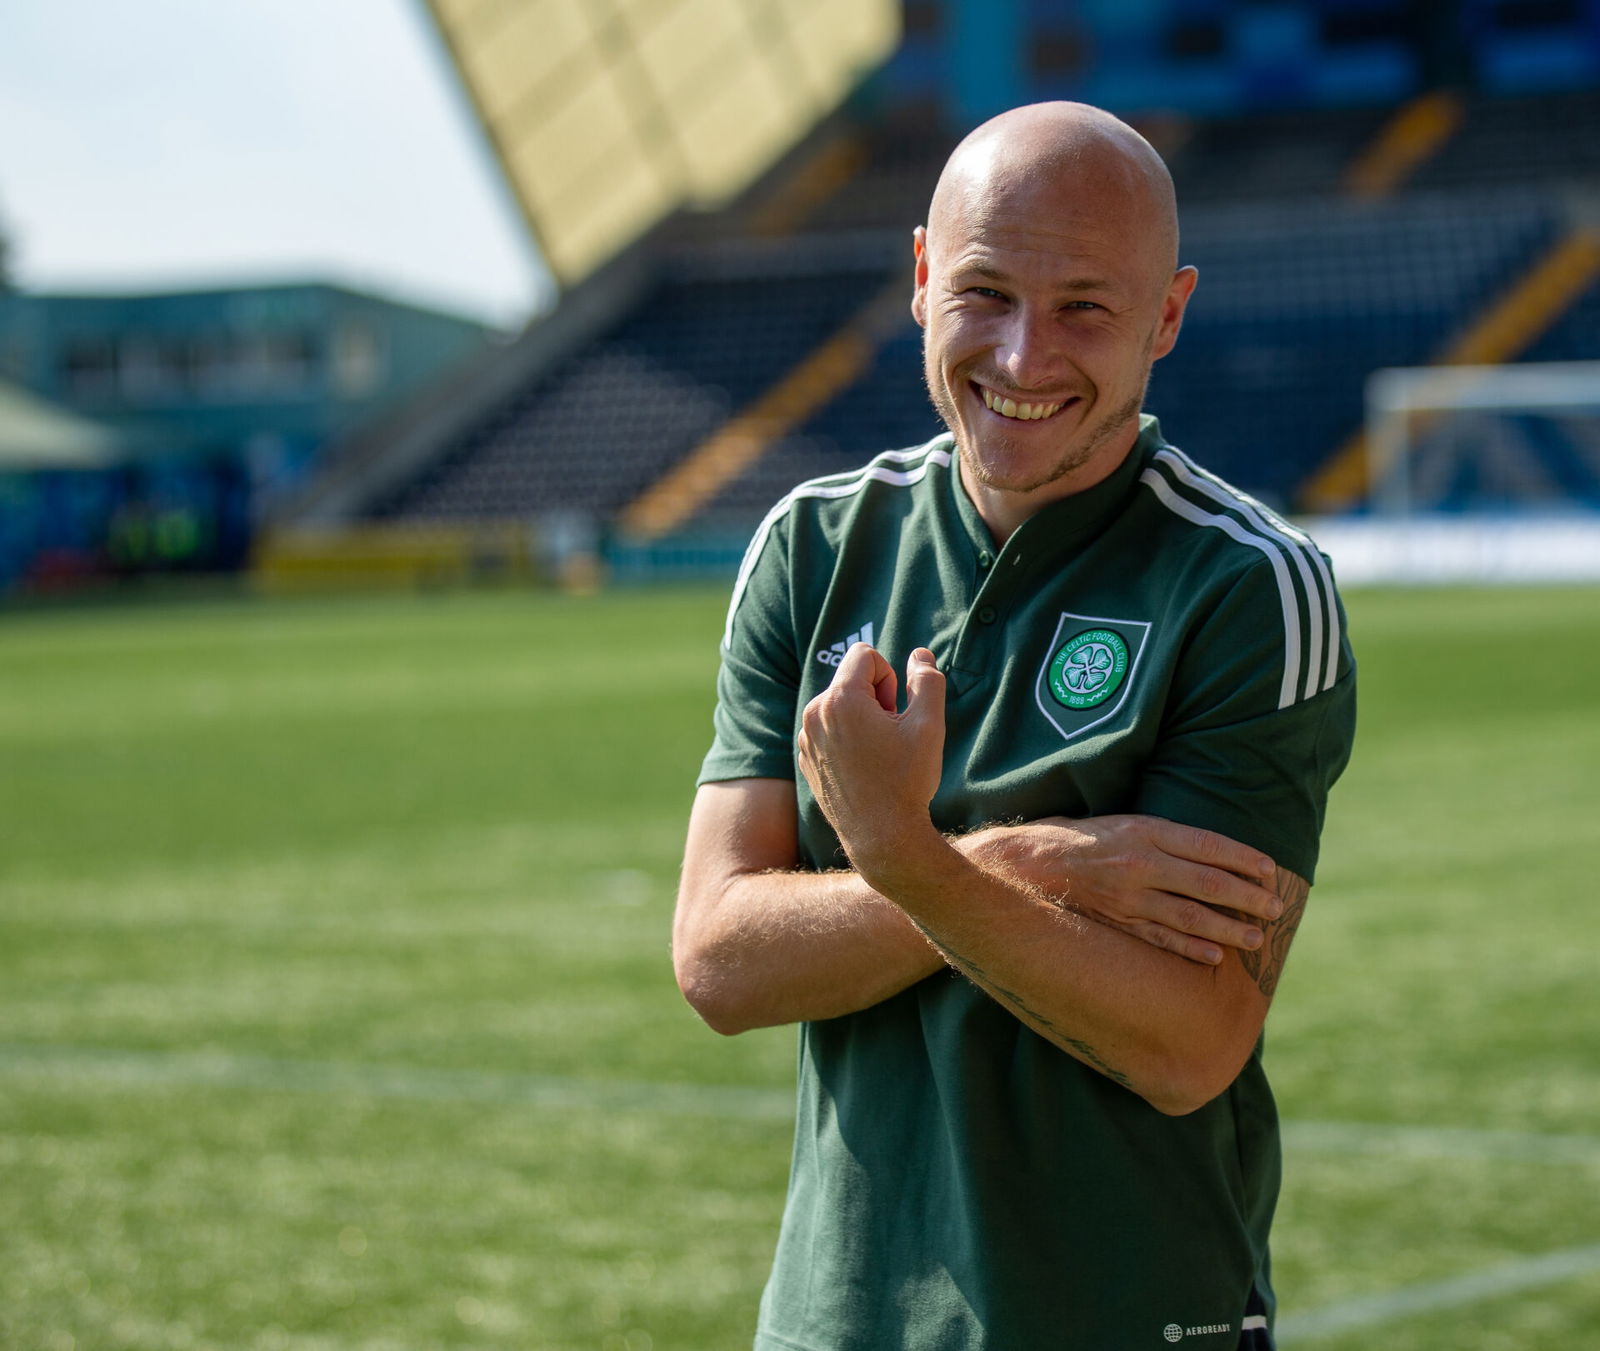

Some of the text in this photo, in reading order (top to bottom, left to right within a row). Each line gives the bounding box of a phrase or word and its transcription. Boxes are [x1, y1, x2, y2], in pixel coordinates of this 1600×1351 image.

[1055, 632, 1125, 673] THE CELTIC FOOTBALL CLUB
[1186, 1323, 1231, 1336] AEROREADY
